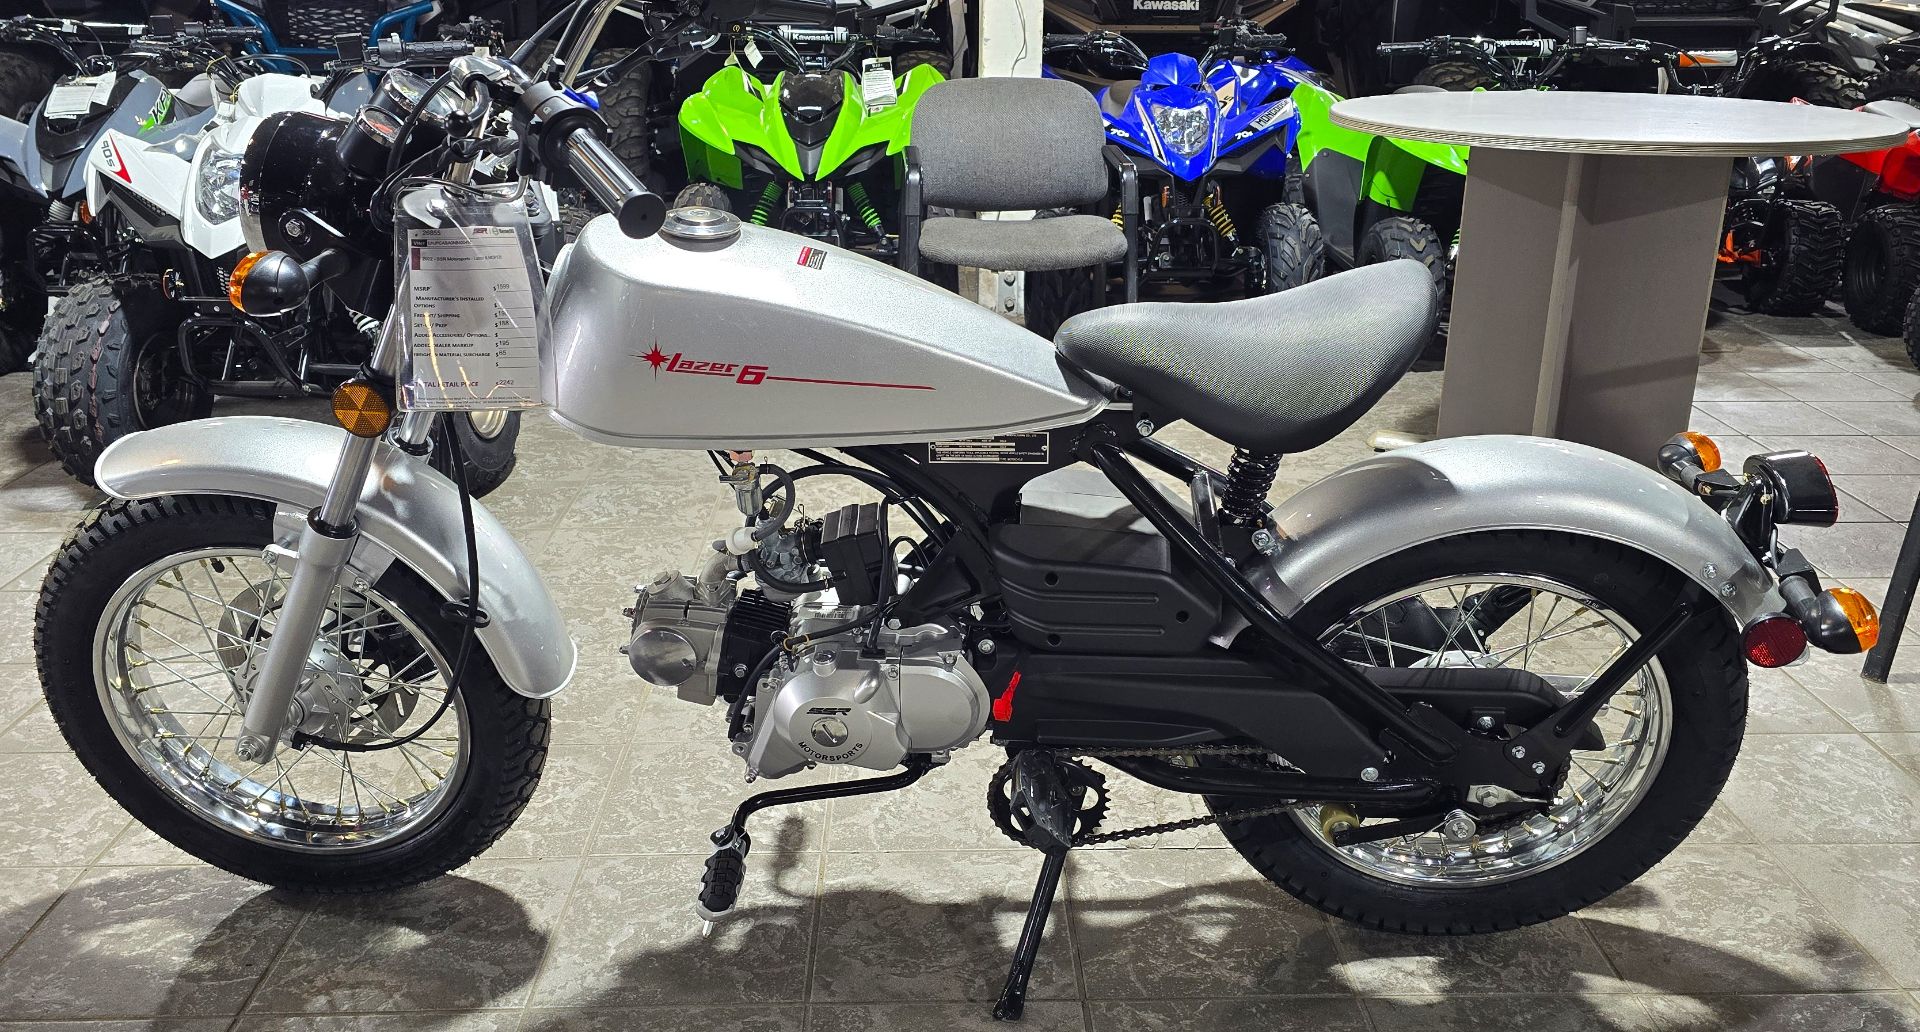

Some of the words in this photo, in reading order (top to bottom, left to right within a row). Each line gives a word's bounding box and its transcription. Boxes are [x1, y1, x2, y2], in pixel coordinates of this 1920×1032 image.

[1132, 0, 1200, 11] Kawasaki
[792, 33, 835, 42] Kawasaki
[666, 353, 740, 374] Lazer
[736, 365, 769, 385] 6
[807, 707, 852, 716] SSR
[798, 741, 863, 762] MOTORSPORTS
